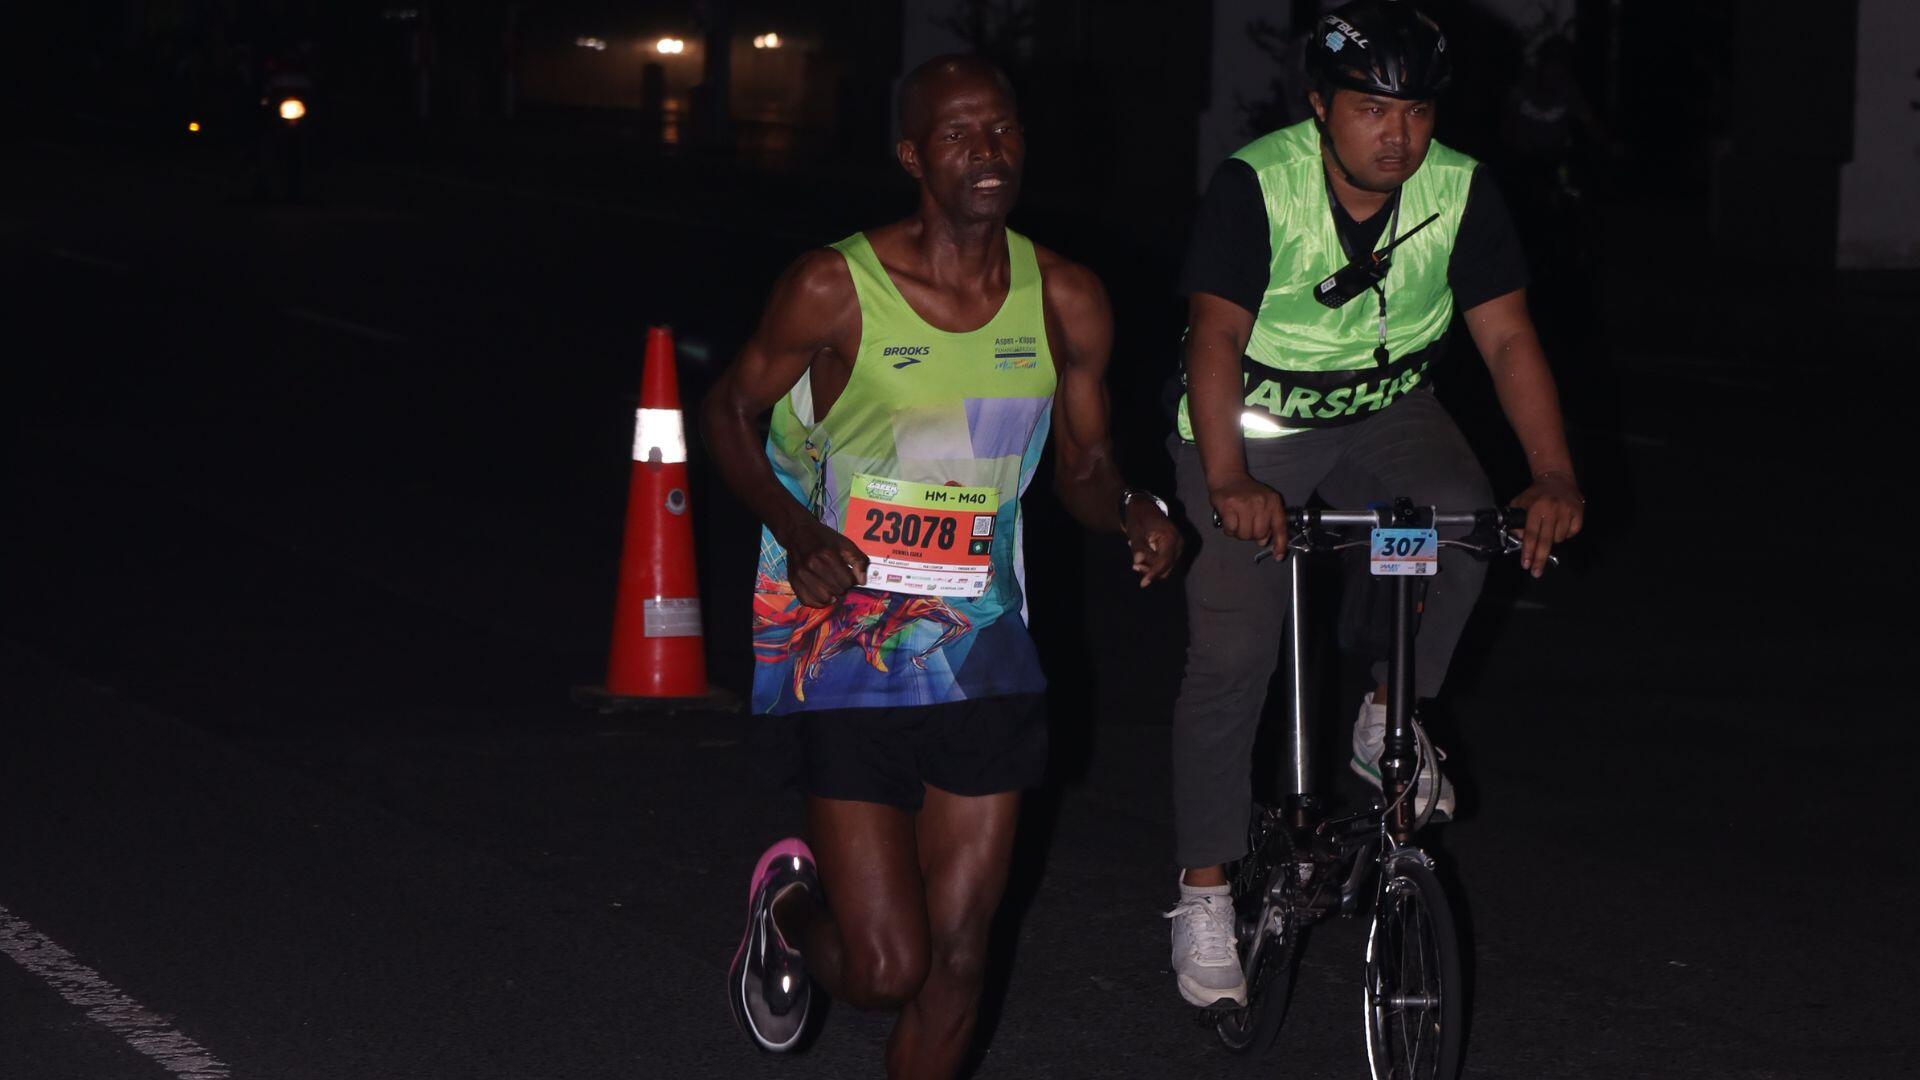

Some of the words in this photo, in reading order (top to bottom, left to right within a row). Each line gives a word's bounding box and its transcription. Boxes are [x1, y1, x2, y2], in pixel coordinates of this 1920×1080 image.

[883, 346, 931, 356] BROOKS
[925, 490, 947, 502] HM
[958, 493, 986, 504] M40
[863, 508, 957, 550] 23078
[1381, 537, 1426, 556] 307
